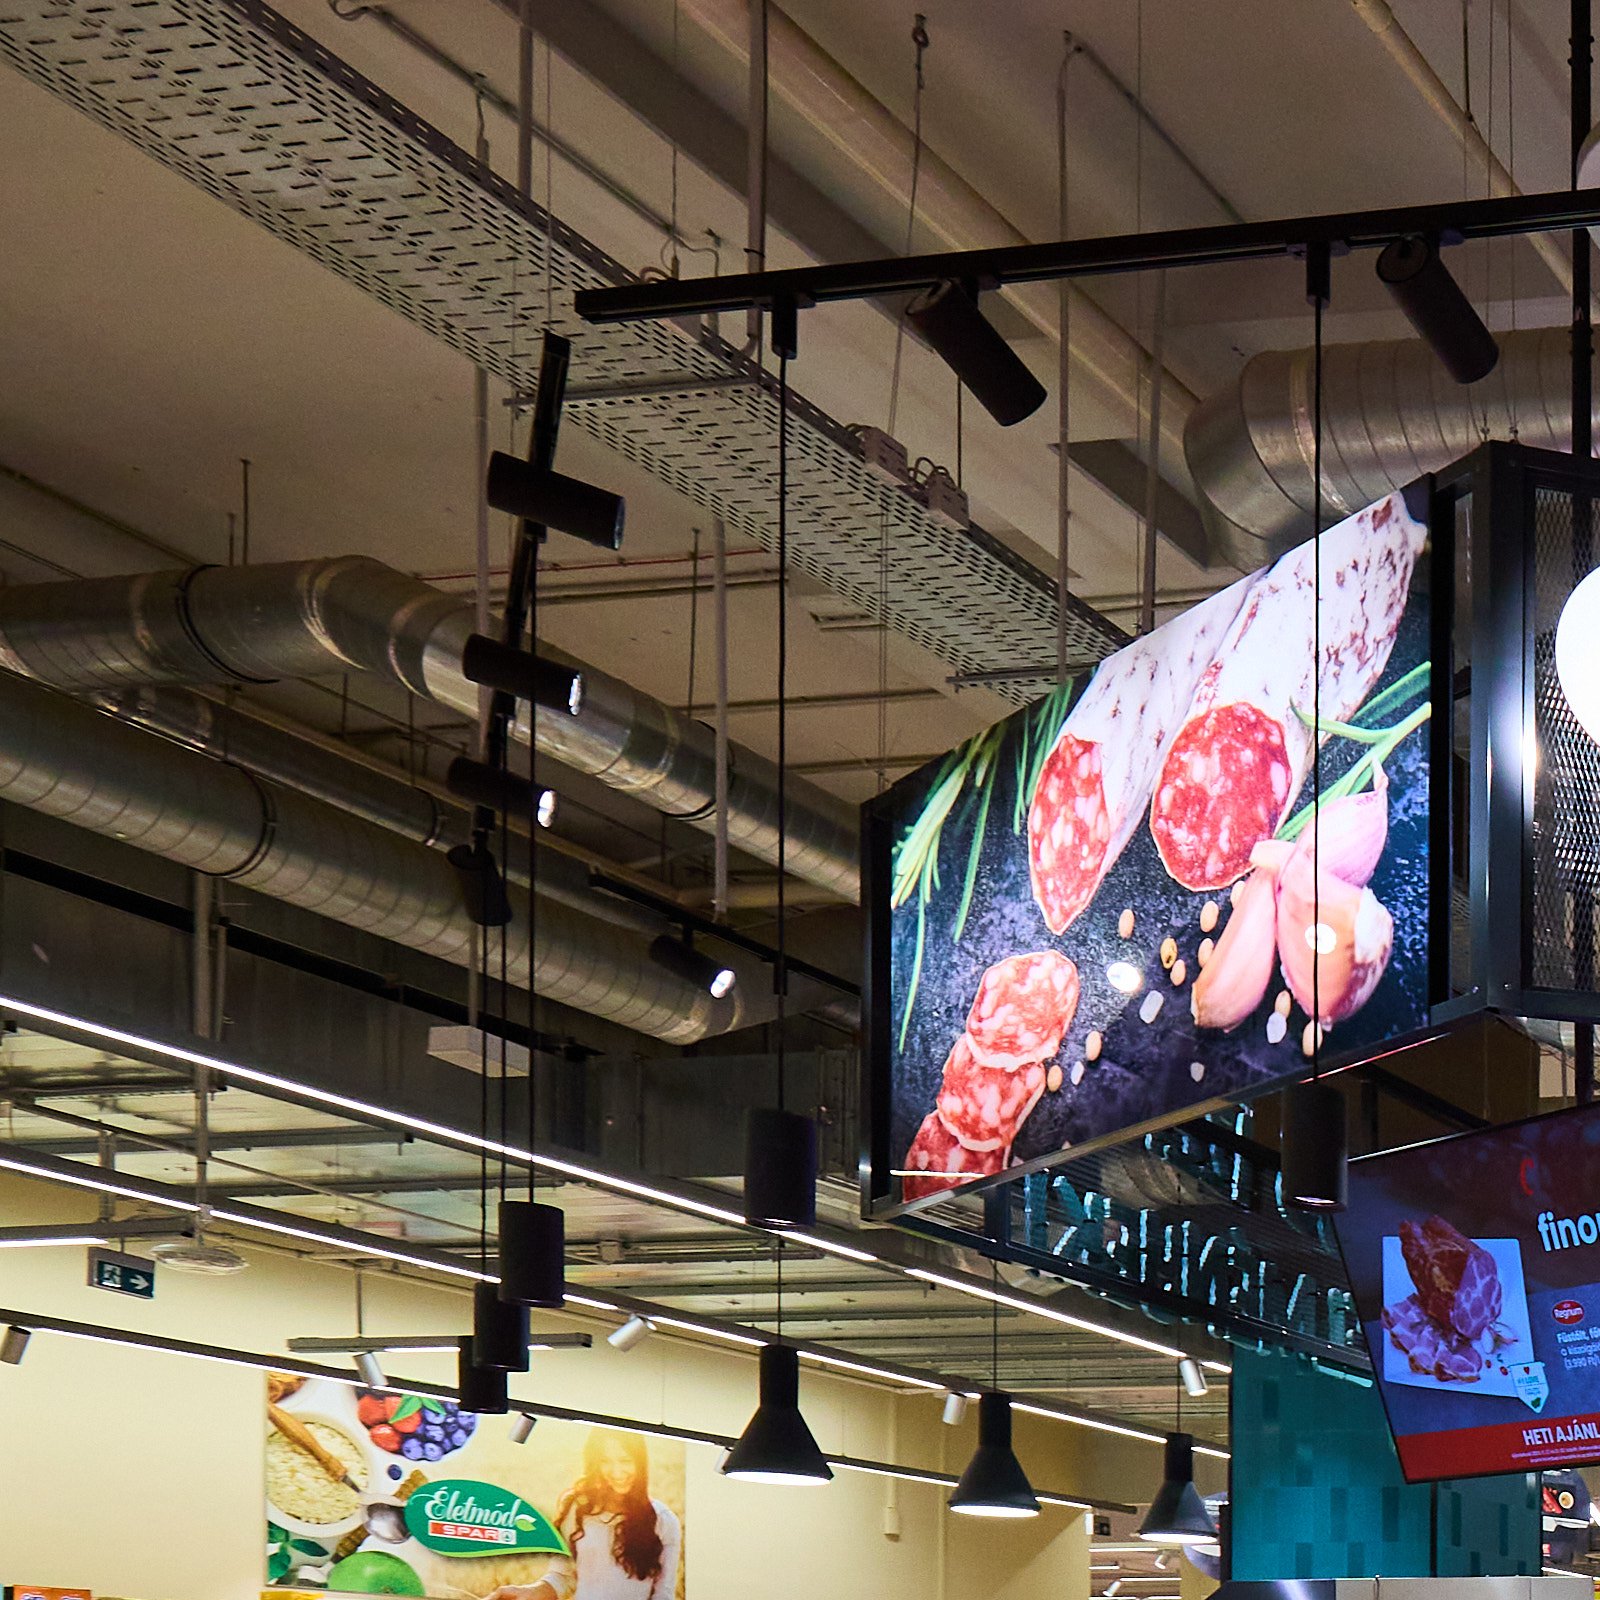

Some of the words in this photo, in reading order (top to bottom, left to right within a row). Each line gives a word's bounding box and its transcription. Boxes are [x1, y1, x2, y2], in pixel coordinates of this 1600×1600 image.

[1522, 1427, 1554, 1446] HETI
[418, 1486, 522, 1527] Életmód
[443, 1525, 498, 1540] SPAR
